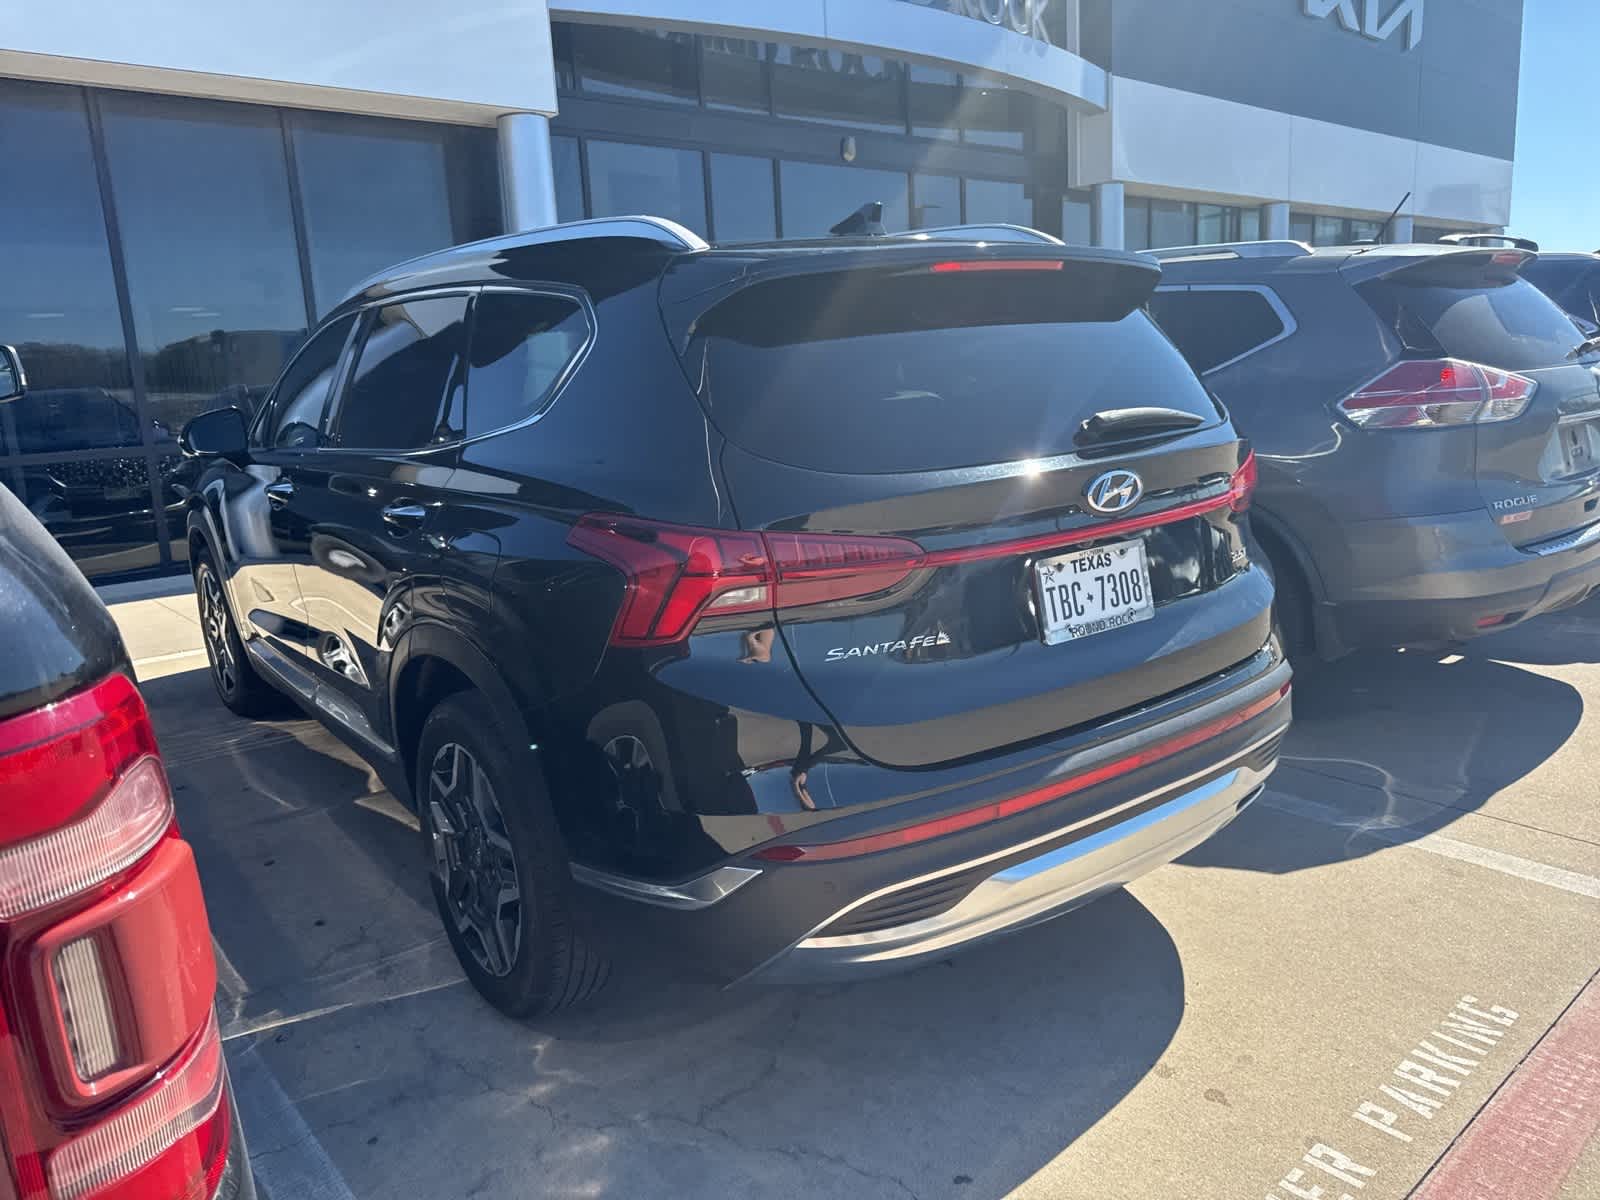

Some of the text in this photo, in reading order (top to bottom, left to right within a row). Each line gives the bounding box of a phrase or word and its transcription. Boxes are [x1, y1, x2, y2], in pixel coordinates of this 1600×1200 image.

[1493, 494, 1537, 510] ROGUE
[1071, 553, 1112, 574] TEXAS
[1070, 613, 1134, 638] ROUND ROCK
[1352, 995, 1519, 1142] PARKING
